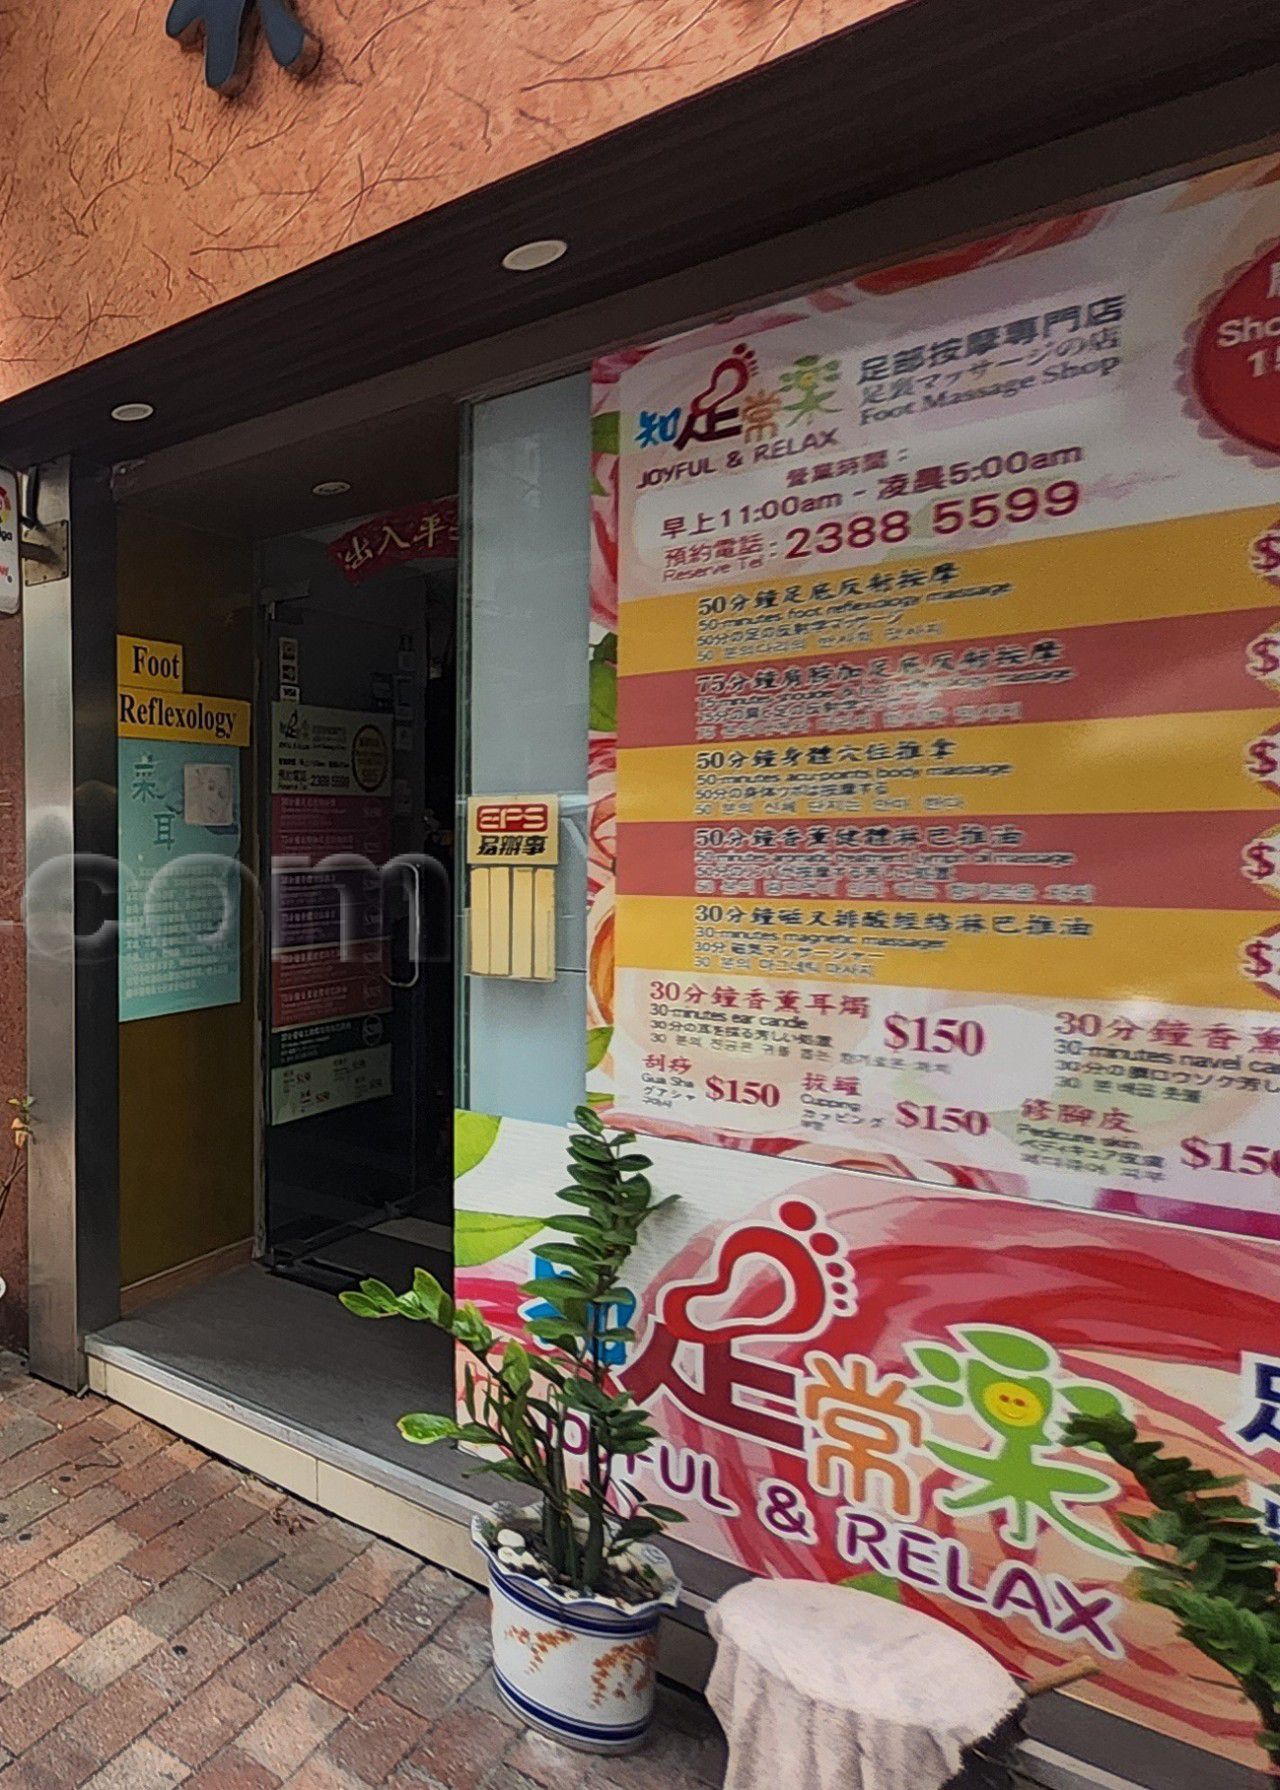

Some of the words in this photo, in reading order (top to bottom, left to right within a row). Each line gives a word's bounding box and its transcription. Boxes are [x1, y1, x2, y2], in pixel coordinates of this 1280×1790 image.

[860, 402, 916, 425] Foot
[922, 375, 1037, 407] Massage
[1042, 356, 1121, 384] Shop
[636, 458, 717, 489] JOYFUL
[726, 451, 744, 468] &
[754, 428, 839, 461] RELAX
[785, 510, 910, 559] 2388
[933, 480, 1080, 535] 5599
[133, 645, 180, 680] Foot
[120, 693, 237, 739] Reflexology
[479, 807, 546, 829] EPS
[478, 835, 548, 856] 易辦事
[732, 1014, 754, 1025] ear
[883, 1011, 985, 1057] $150
[705, 1074, 780, 1109] $150
[895, 1100, 990, 1136] $150
[767, 1486, 806, 1538] &
[842, 1513, 1120, 1656] RELAX
